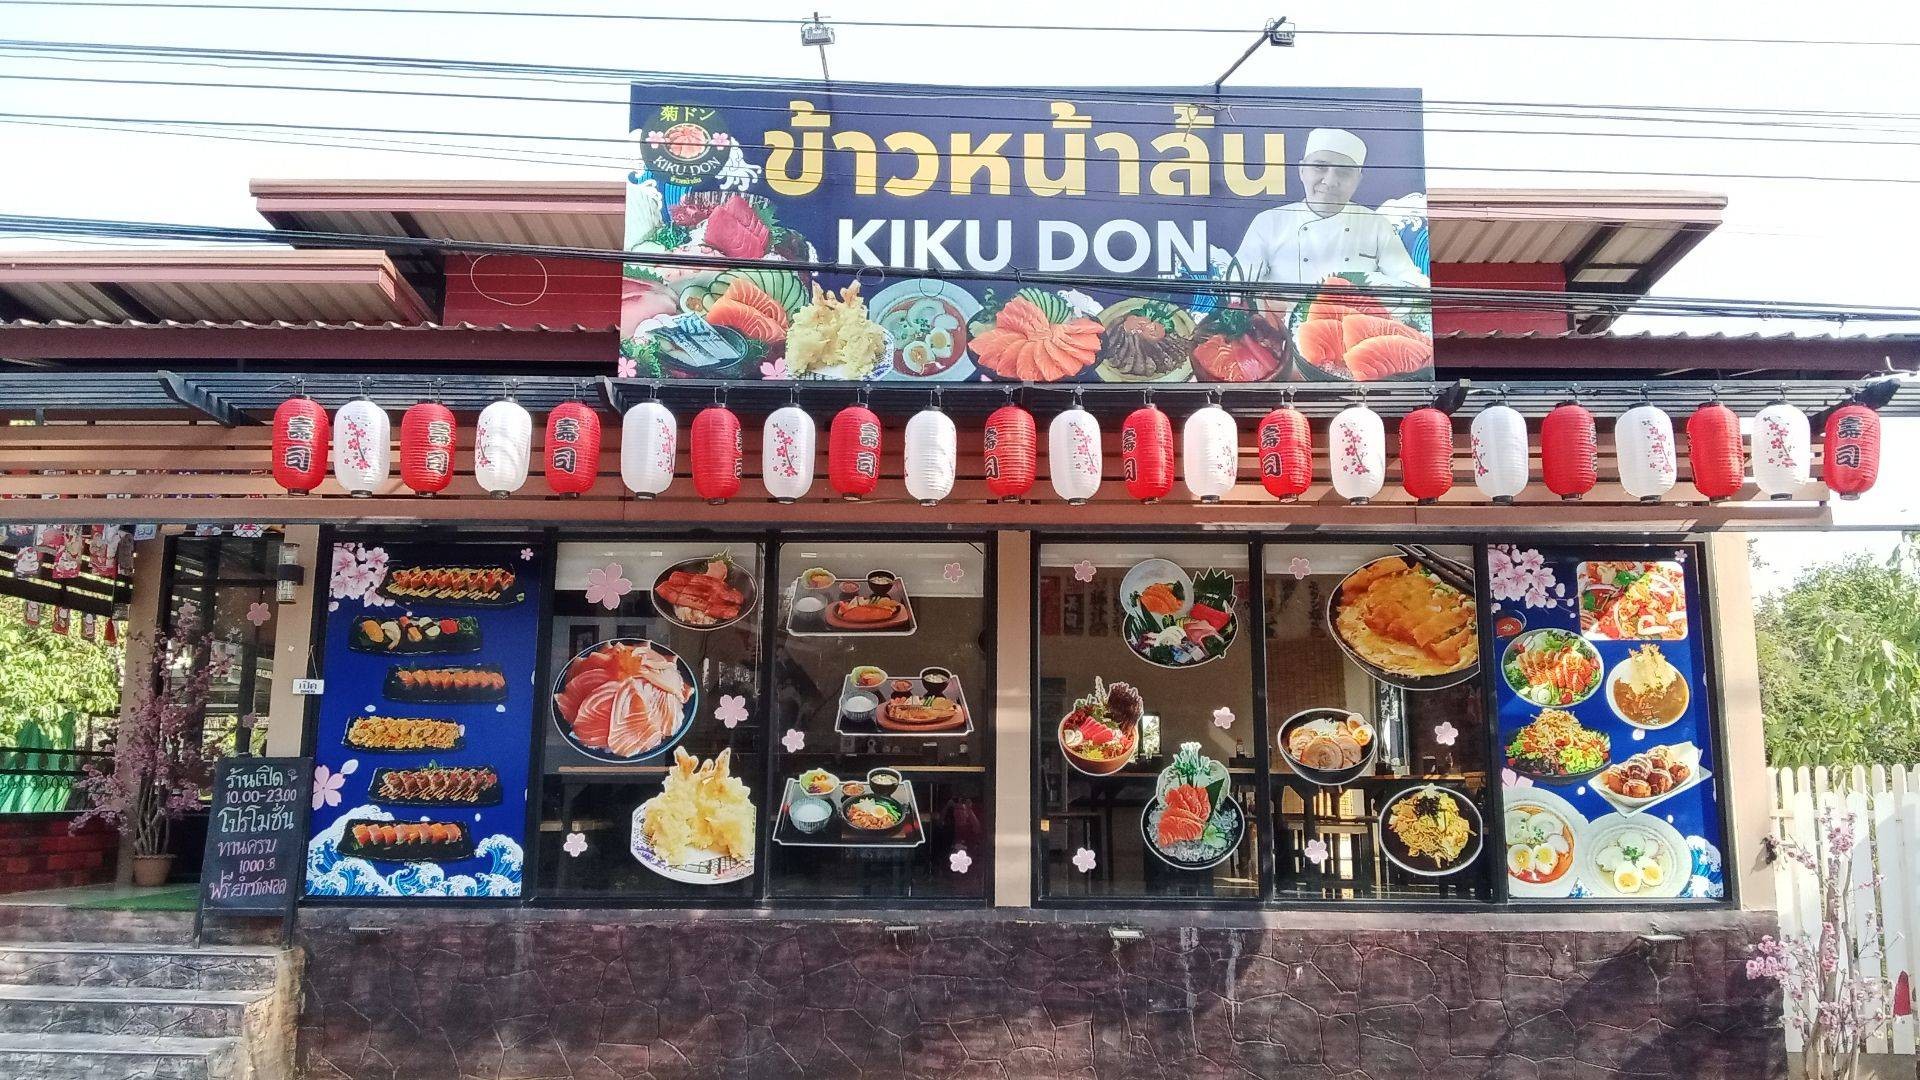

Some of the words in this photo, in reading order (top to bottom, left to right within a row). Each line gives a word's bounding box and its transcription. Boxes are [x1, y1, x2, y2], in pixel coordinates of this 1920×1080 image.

[764, 100, 1286, 197] ข้าวหน้าล้น
[652, 155, 686, 176] KIKU
[690, 156, 722, 176] DON
[837, 218, 1012, 272] KIKU
[1038, 218, 1208, 273] DON
[225, 765, 284, 789] ร้านเปิด
[217, 802, 295, 833] โปรโมชั่น
